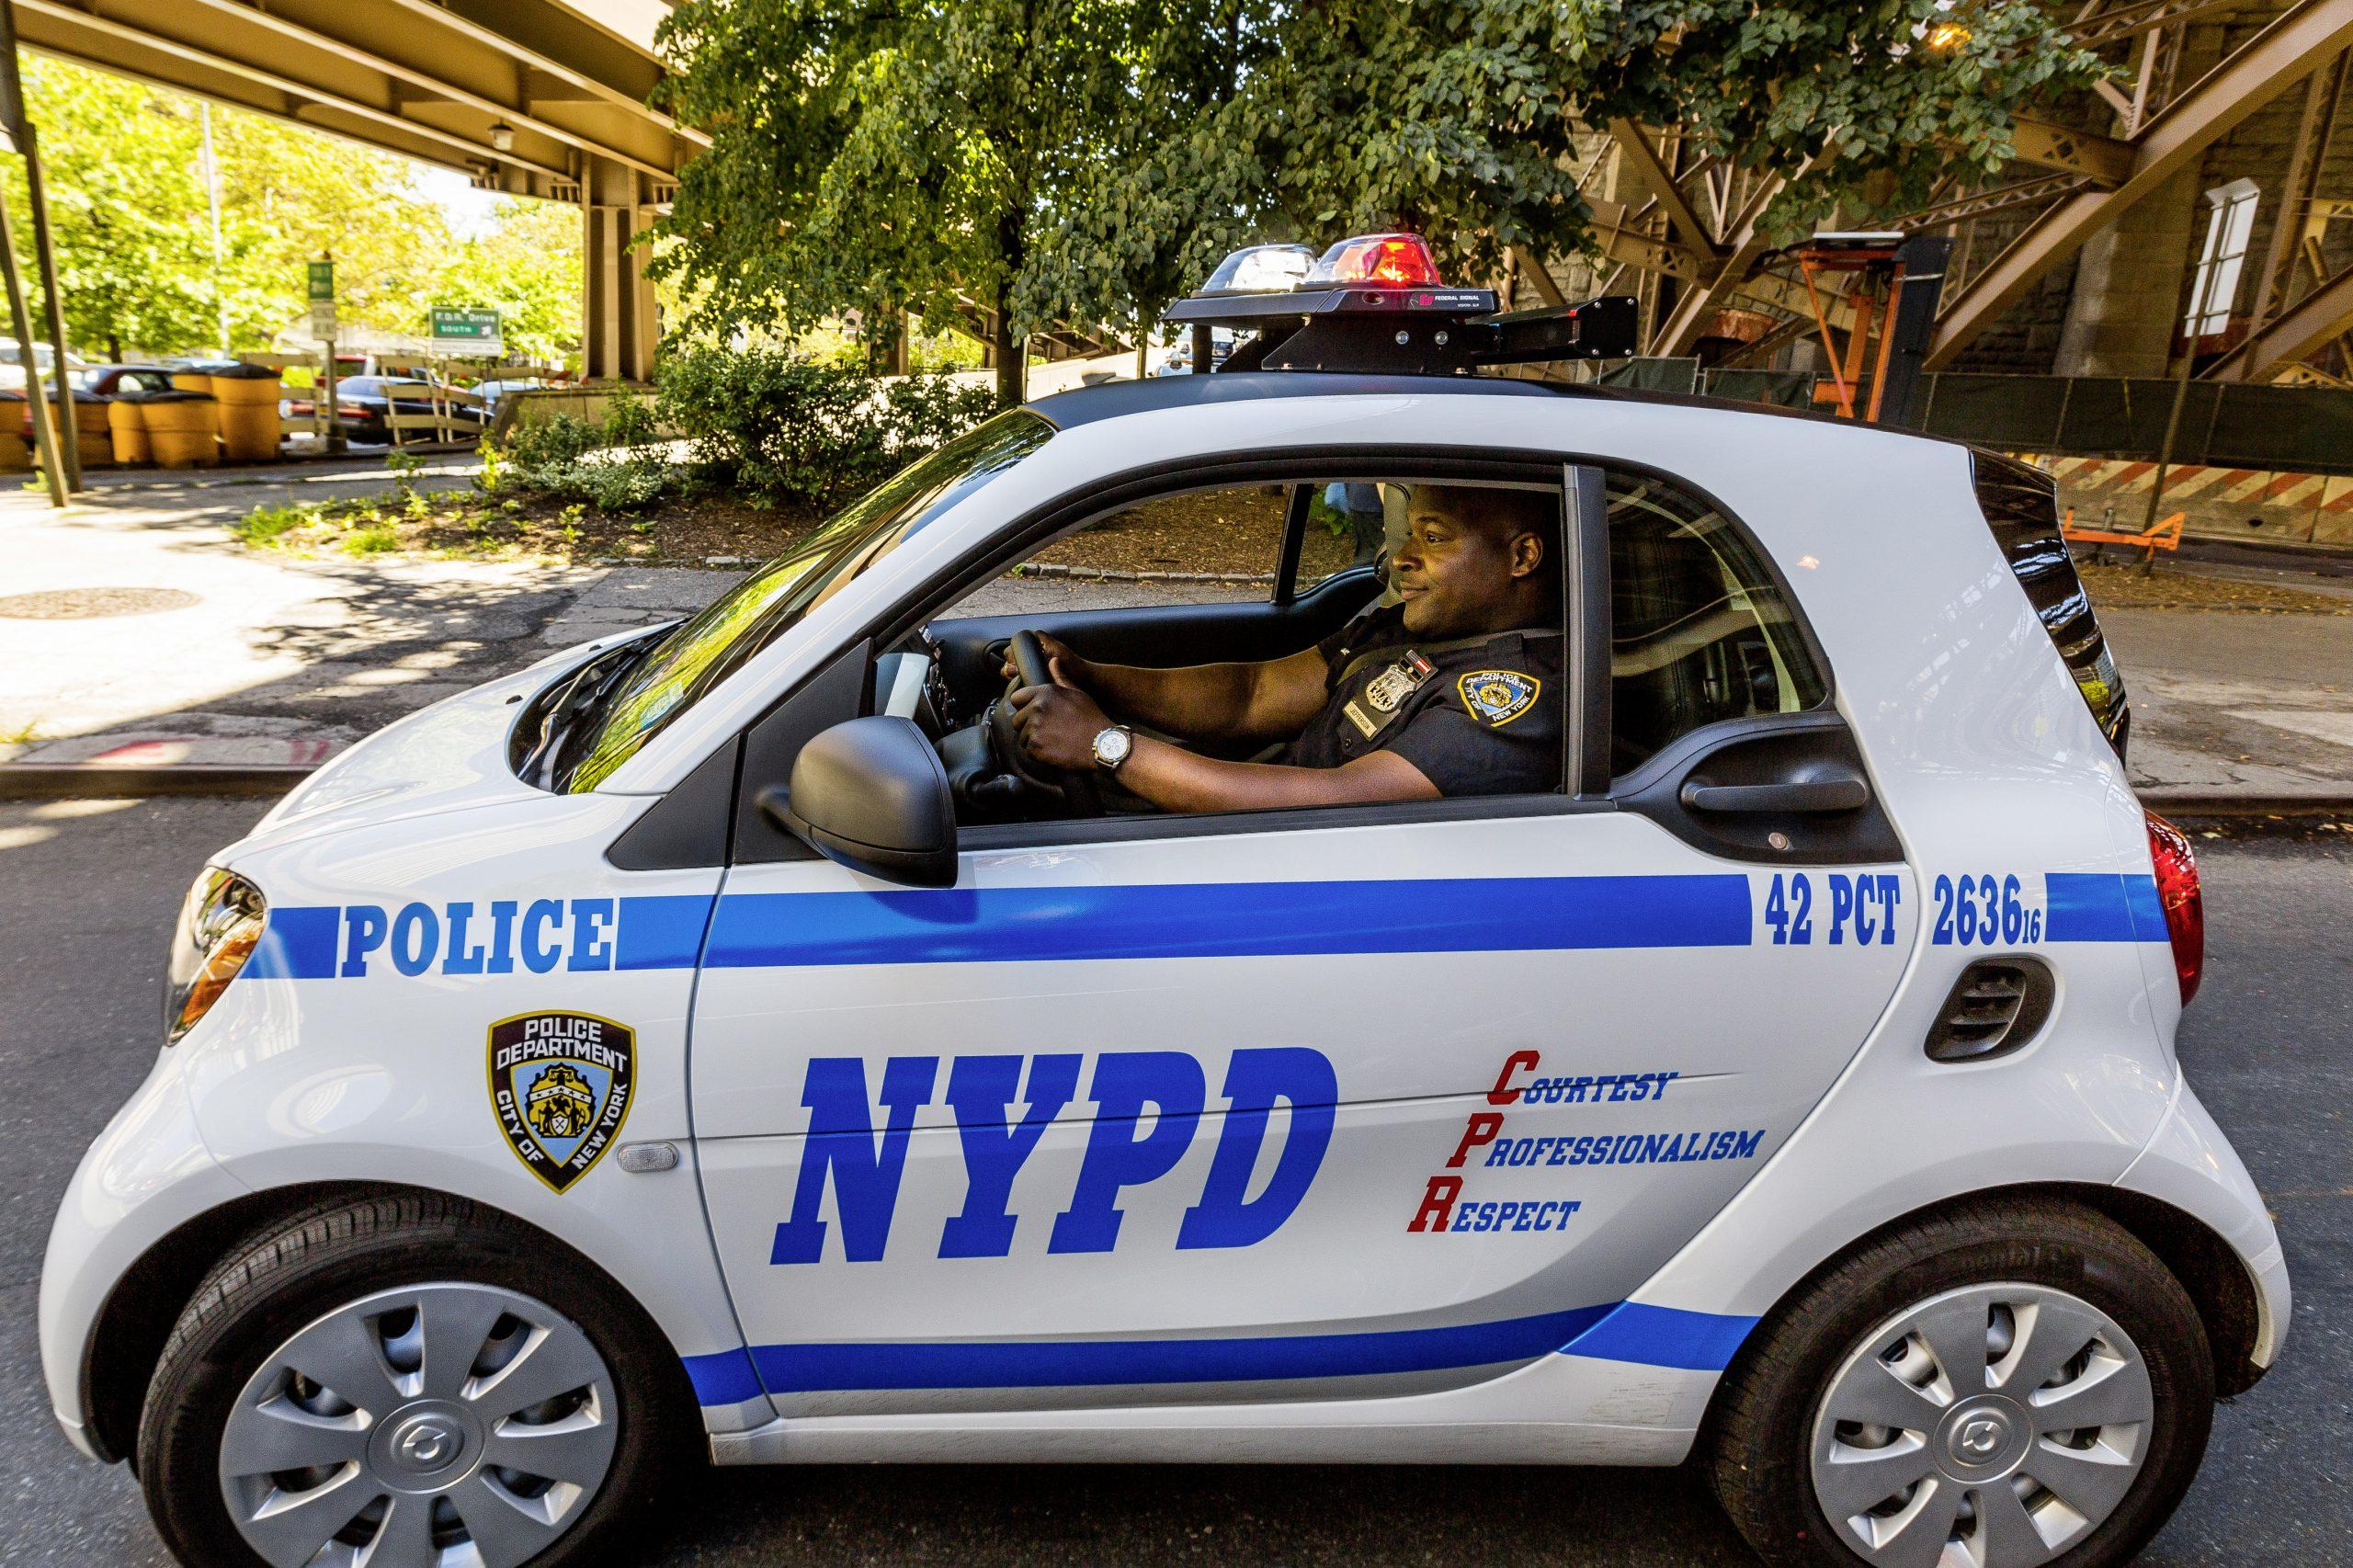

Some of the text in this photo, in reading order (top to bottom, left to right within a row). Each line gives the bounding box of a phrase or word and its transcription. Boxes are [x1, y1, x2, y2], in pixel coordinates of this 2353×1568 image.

[440, 324, 472, 333] SOUTH
[468, 312, 496, 323] Drive
[1466, 676, 1533, 693] DEPARTMENT
[1482, 673, 1520, 681] POLICE
[1349, 708, 1370, 730] JEFFERSON
[1471, 700, 1483, 710] OF
[1492, 696, 1531, 722] NEW YORK
[1765, 872, 1901, 947] 42 PCT
[341, 898, 614, 977] POLICE
[525, 1017, 602, 1042] POLICE
[496, 1038, 628, 1073] DEPARTMENT
[1486, 1050, 1679, 1106] COURTESY
[496, 1090, 544, 1163] CITY OF
[571, 1083, 627, 1170] NEW YORK
[1445, 1112, 1766, 1168] PROFESSIONALISM
[769, 1046, 1338, 1266] NYPD
[1406, 1175, 1581, 1233] RESPECT
